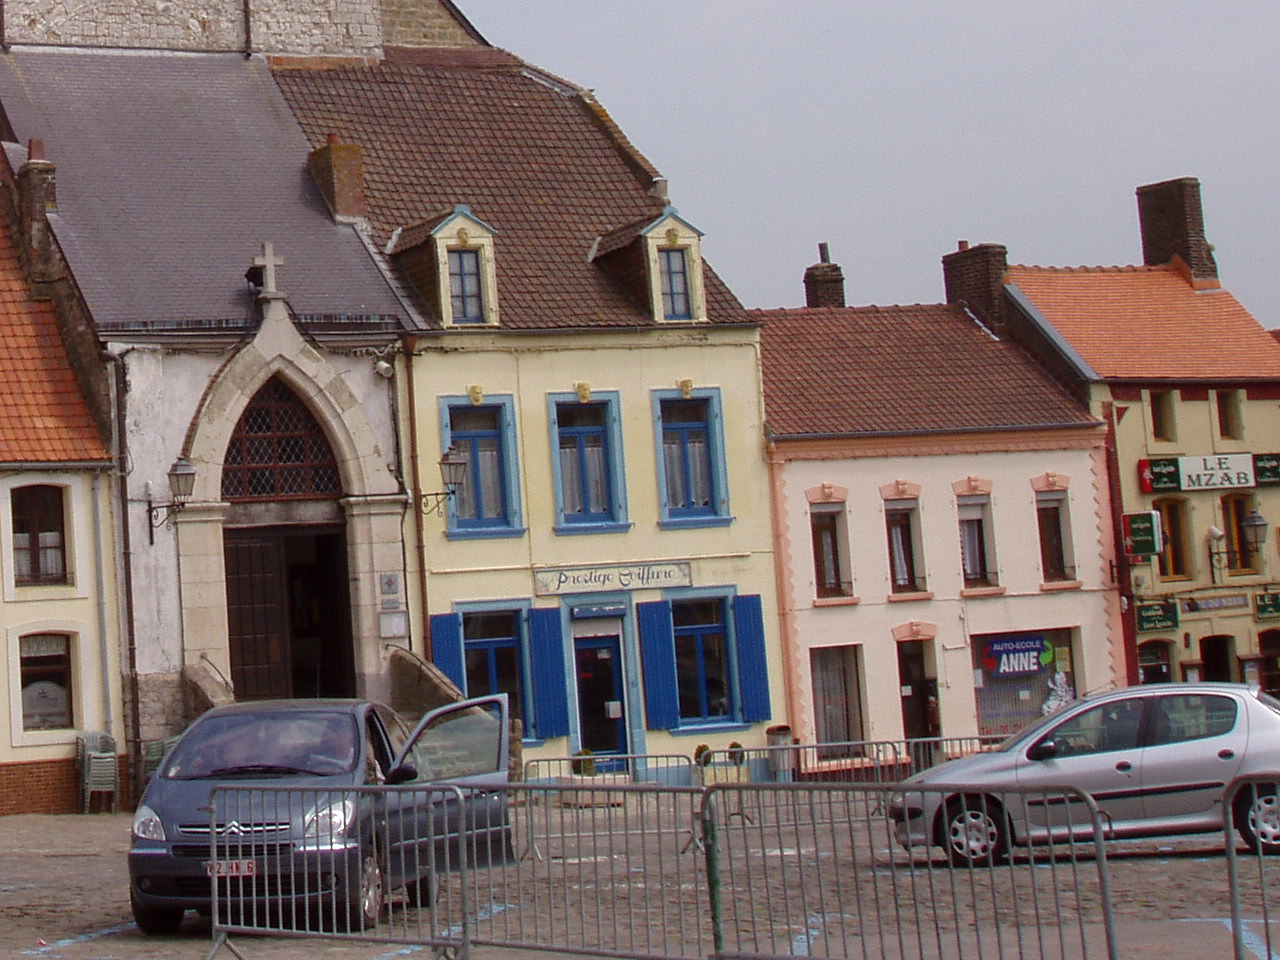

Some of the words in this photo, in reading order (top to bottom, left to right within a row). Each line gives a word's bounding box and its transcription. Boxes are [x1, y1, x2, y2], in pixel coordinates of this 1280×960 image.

[1202, 457, 1231, 471] LE
[1187, 471, 1249, 487] MZAB
[993, 640, 1042, 651] AUTO-ECOLE
[999, 651, 1039, 673] ANNE
